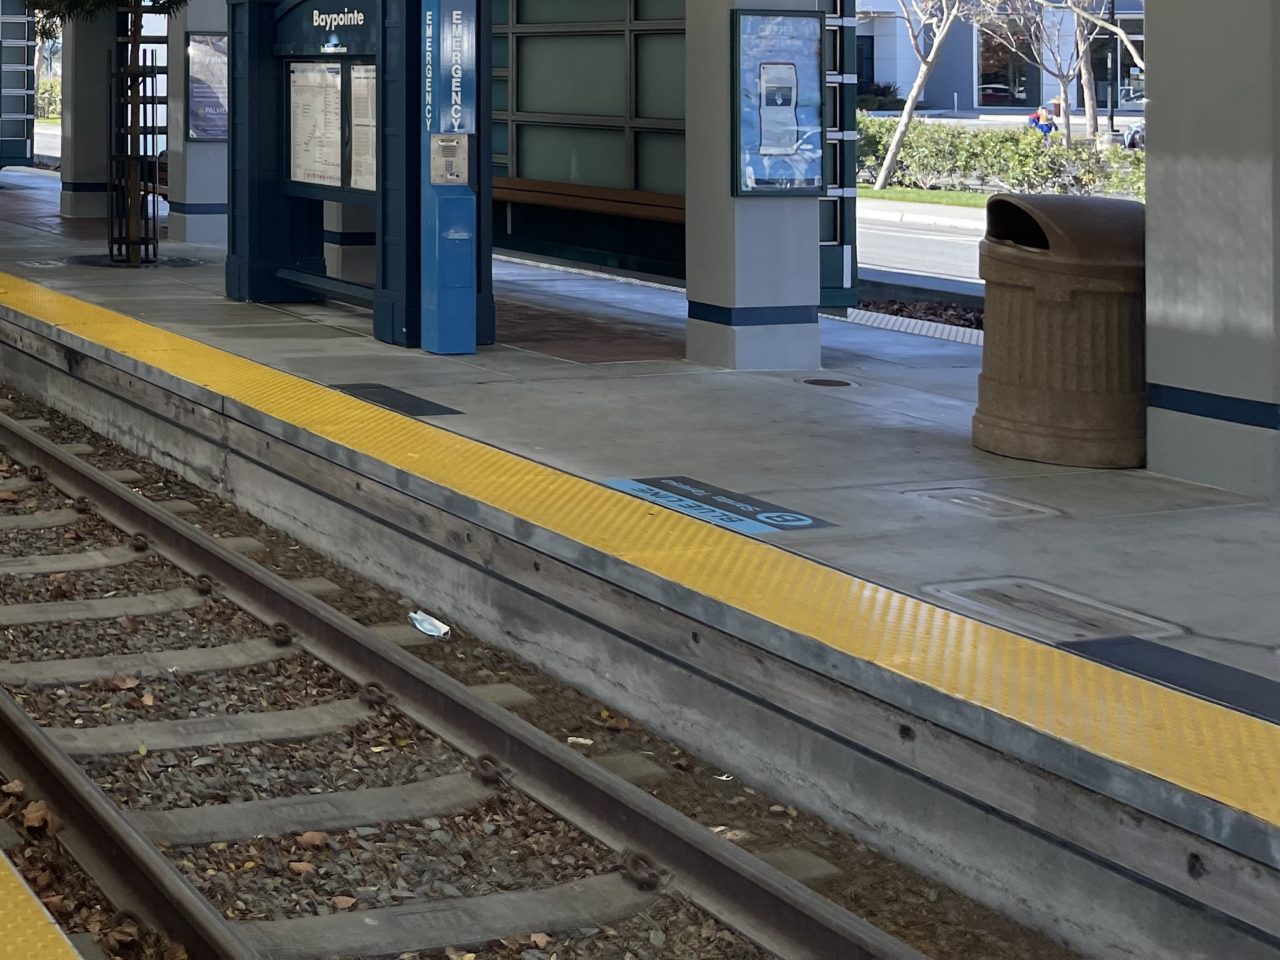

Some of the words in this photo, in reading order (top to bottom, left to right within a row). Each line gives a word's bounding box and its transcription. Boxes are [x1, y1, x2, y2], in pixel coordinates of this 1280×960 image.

[313, 7, 365, 31] Baypointe
[425, 11, 433, 132] EMERGENCY
[451, 10, 463, 132] EMERGENCY
